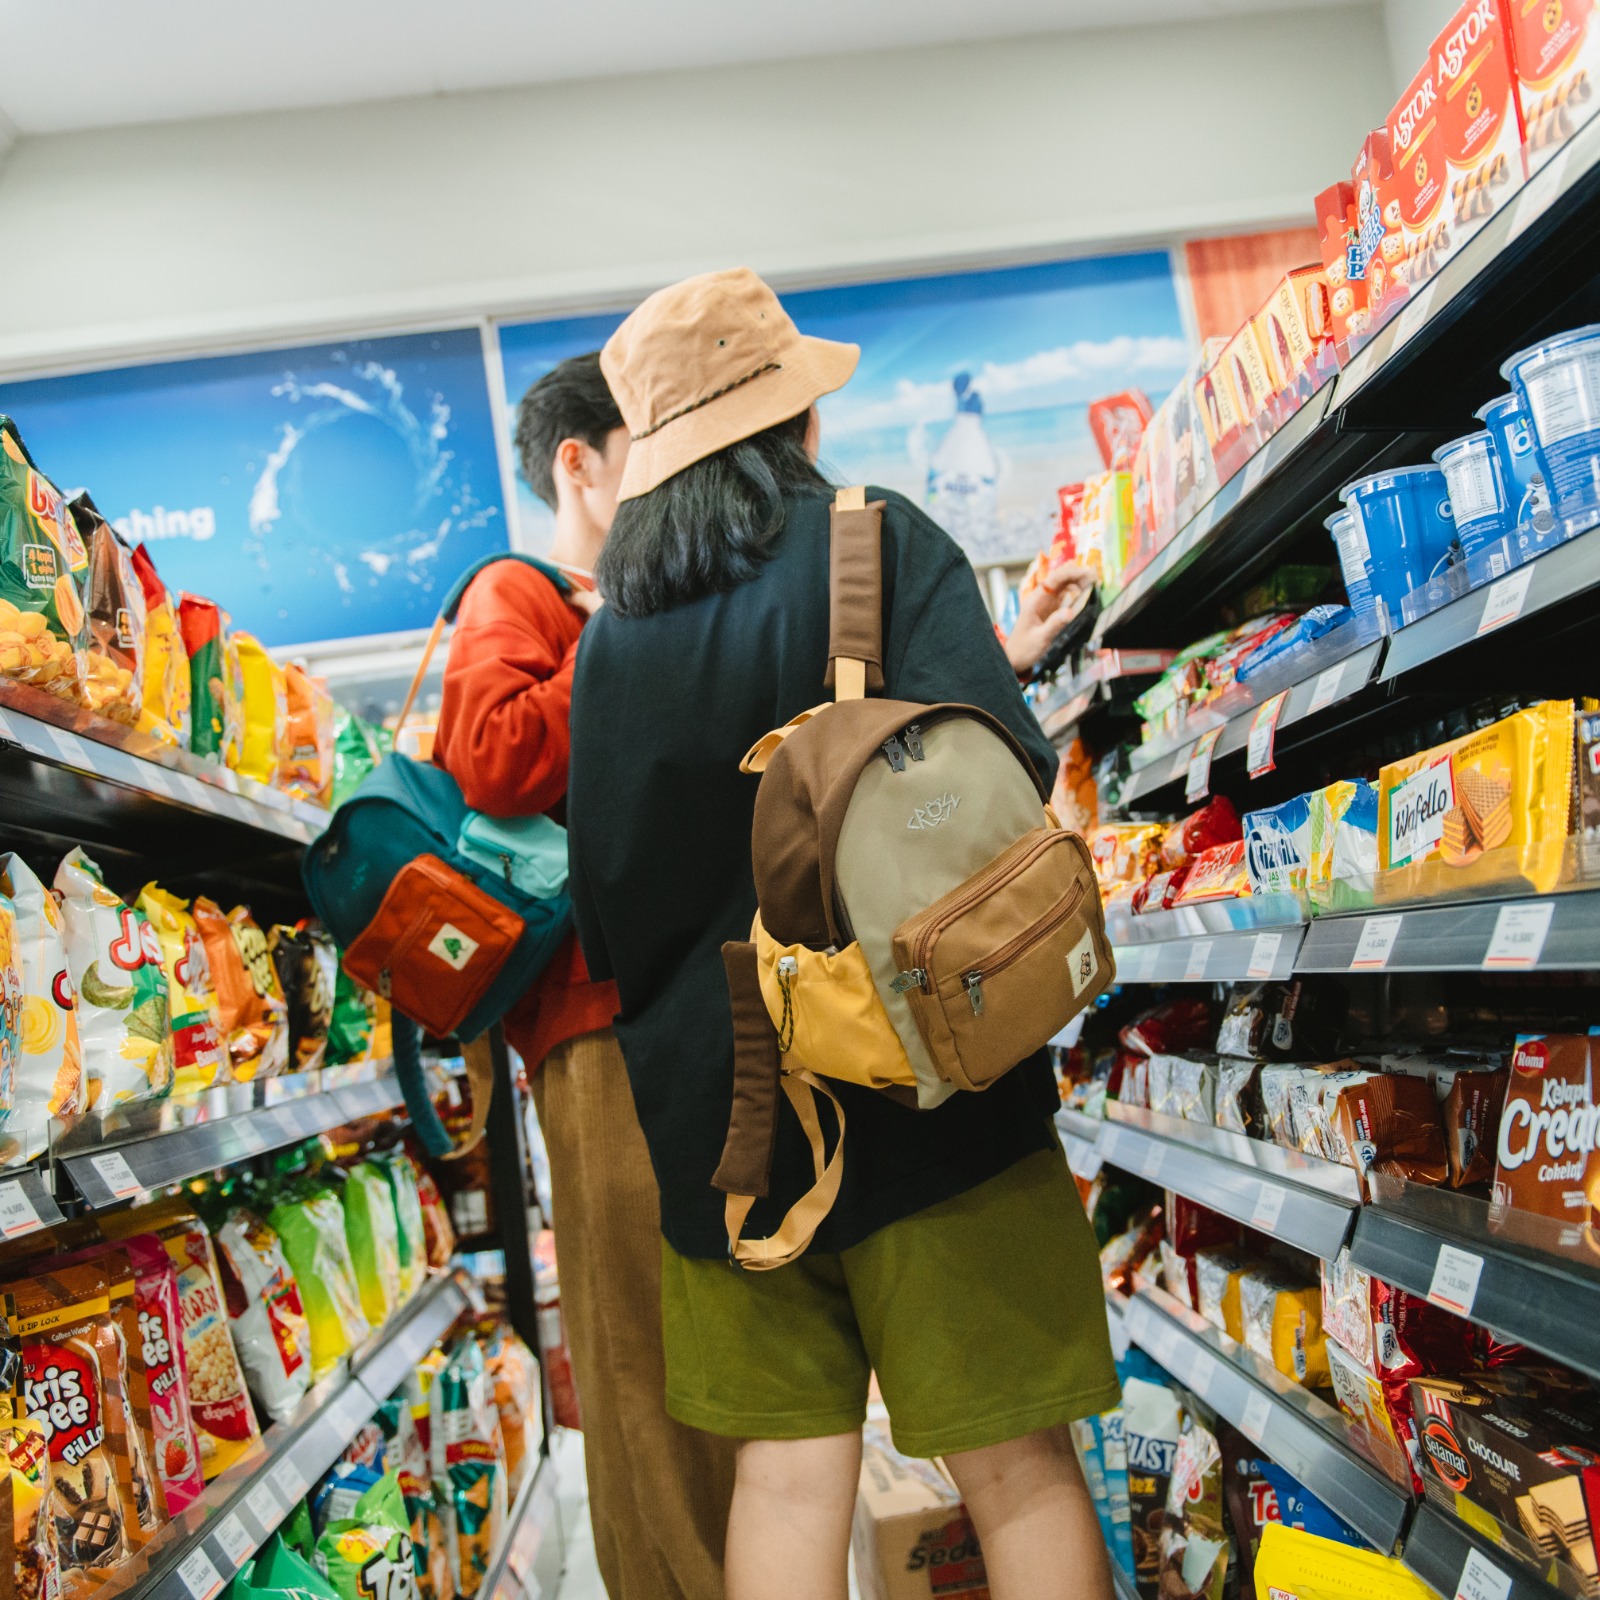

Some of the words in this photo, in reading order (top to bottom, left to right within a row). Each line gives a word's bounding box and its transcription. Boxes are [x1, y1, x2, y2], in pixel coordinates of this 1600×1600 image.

[1437, 0, 1496, 87] ASTOR
[1392, 76, 1438, 156] ASTOR
[1464, 107, 1490, 140] CHOCOLATE
[1414, 177, 1434, 205] CHOCOLATE
[112, 505, 216, 541] shing
[1396, 779, 1447, 840] Wafello
[1516, 1051, 1544, 1069] Roma
[1538, 1160, 1583, 1182] Cokelat
[27, 1321, 39, 1331] ZIP
[40, 1315, 60, 1326] LOCK
[1426, 1434, 1467, 1475] Selamat
[1467, 1437, 1521, 1482] CHOCOLATE
